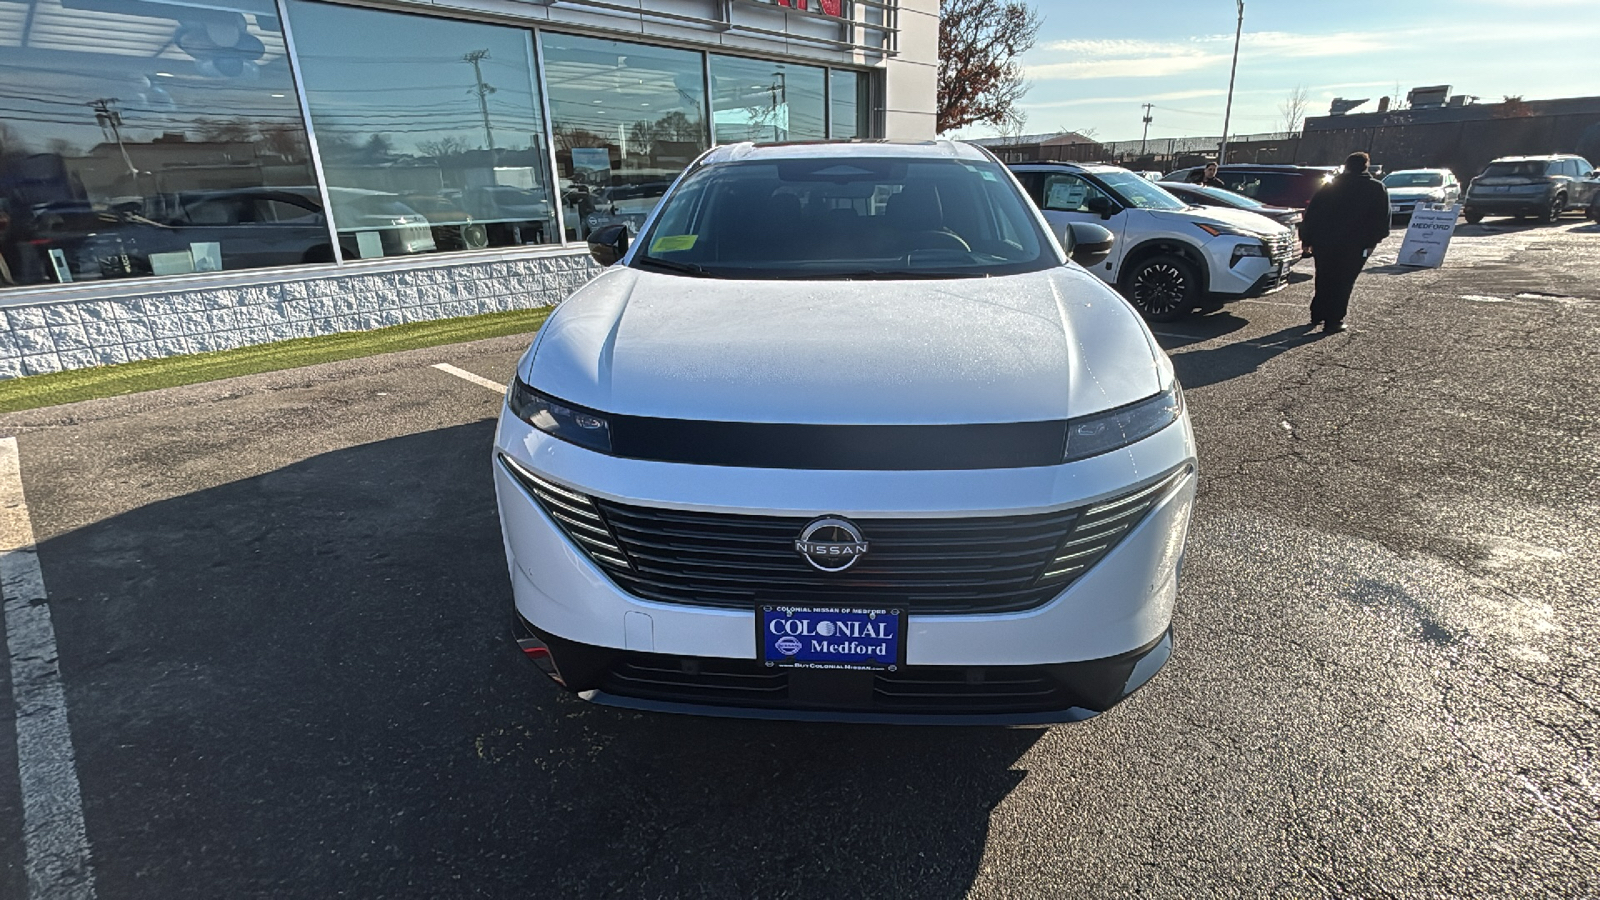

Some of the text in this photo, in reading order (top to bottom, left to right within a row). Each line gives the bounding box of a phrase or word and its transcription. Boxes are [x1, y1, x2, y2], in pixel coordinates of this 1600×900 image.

[1412, 223, 1450, 231] MEDFORD
[796, 542, 867, 555] NISSAN
[769, 619, 893, 639] COLONIAL
[811, 640, 886, 656] Medford
